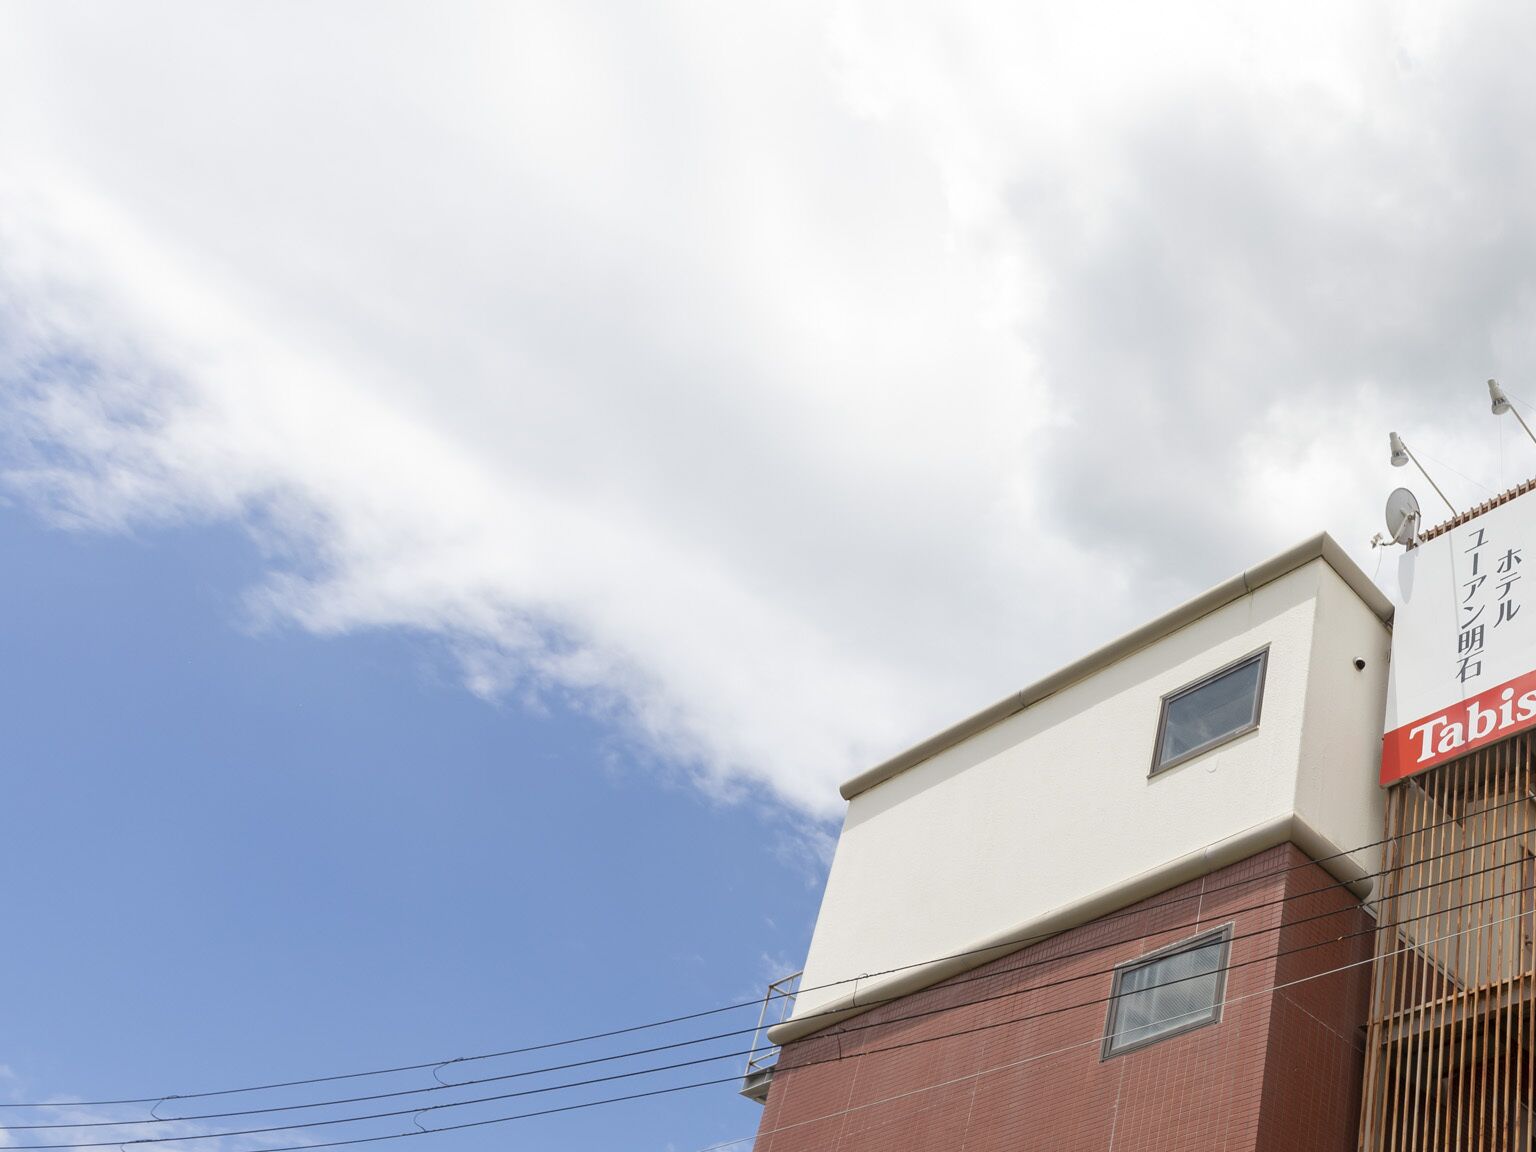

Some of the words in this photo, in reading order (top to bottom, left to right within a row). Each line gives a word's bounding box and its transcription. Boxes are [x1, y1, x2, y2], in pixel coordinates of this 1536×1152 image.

[1455, 527, 1489, 684] ユーアン明石
[1493, 548, 1523, 628] ホテル
